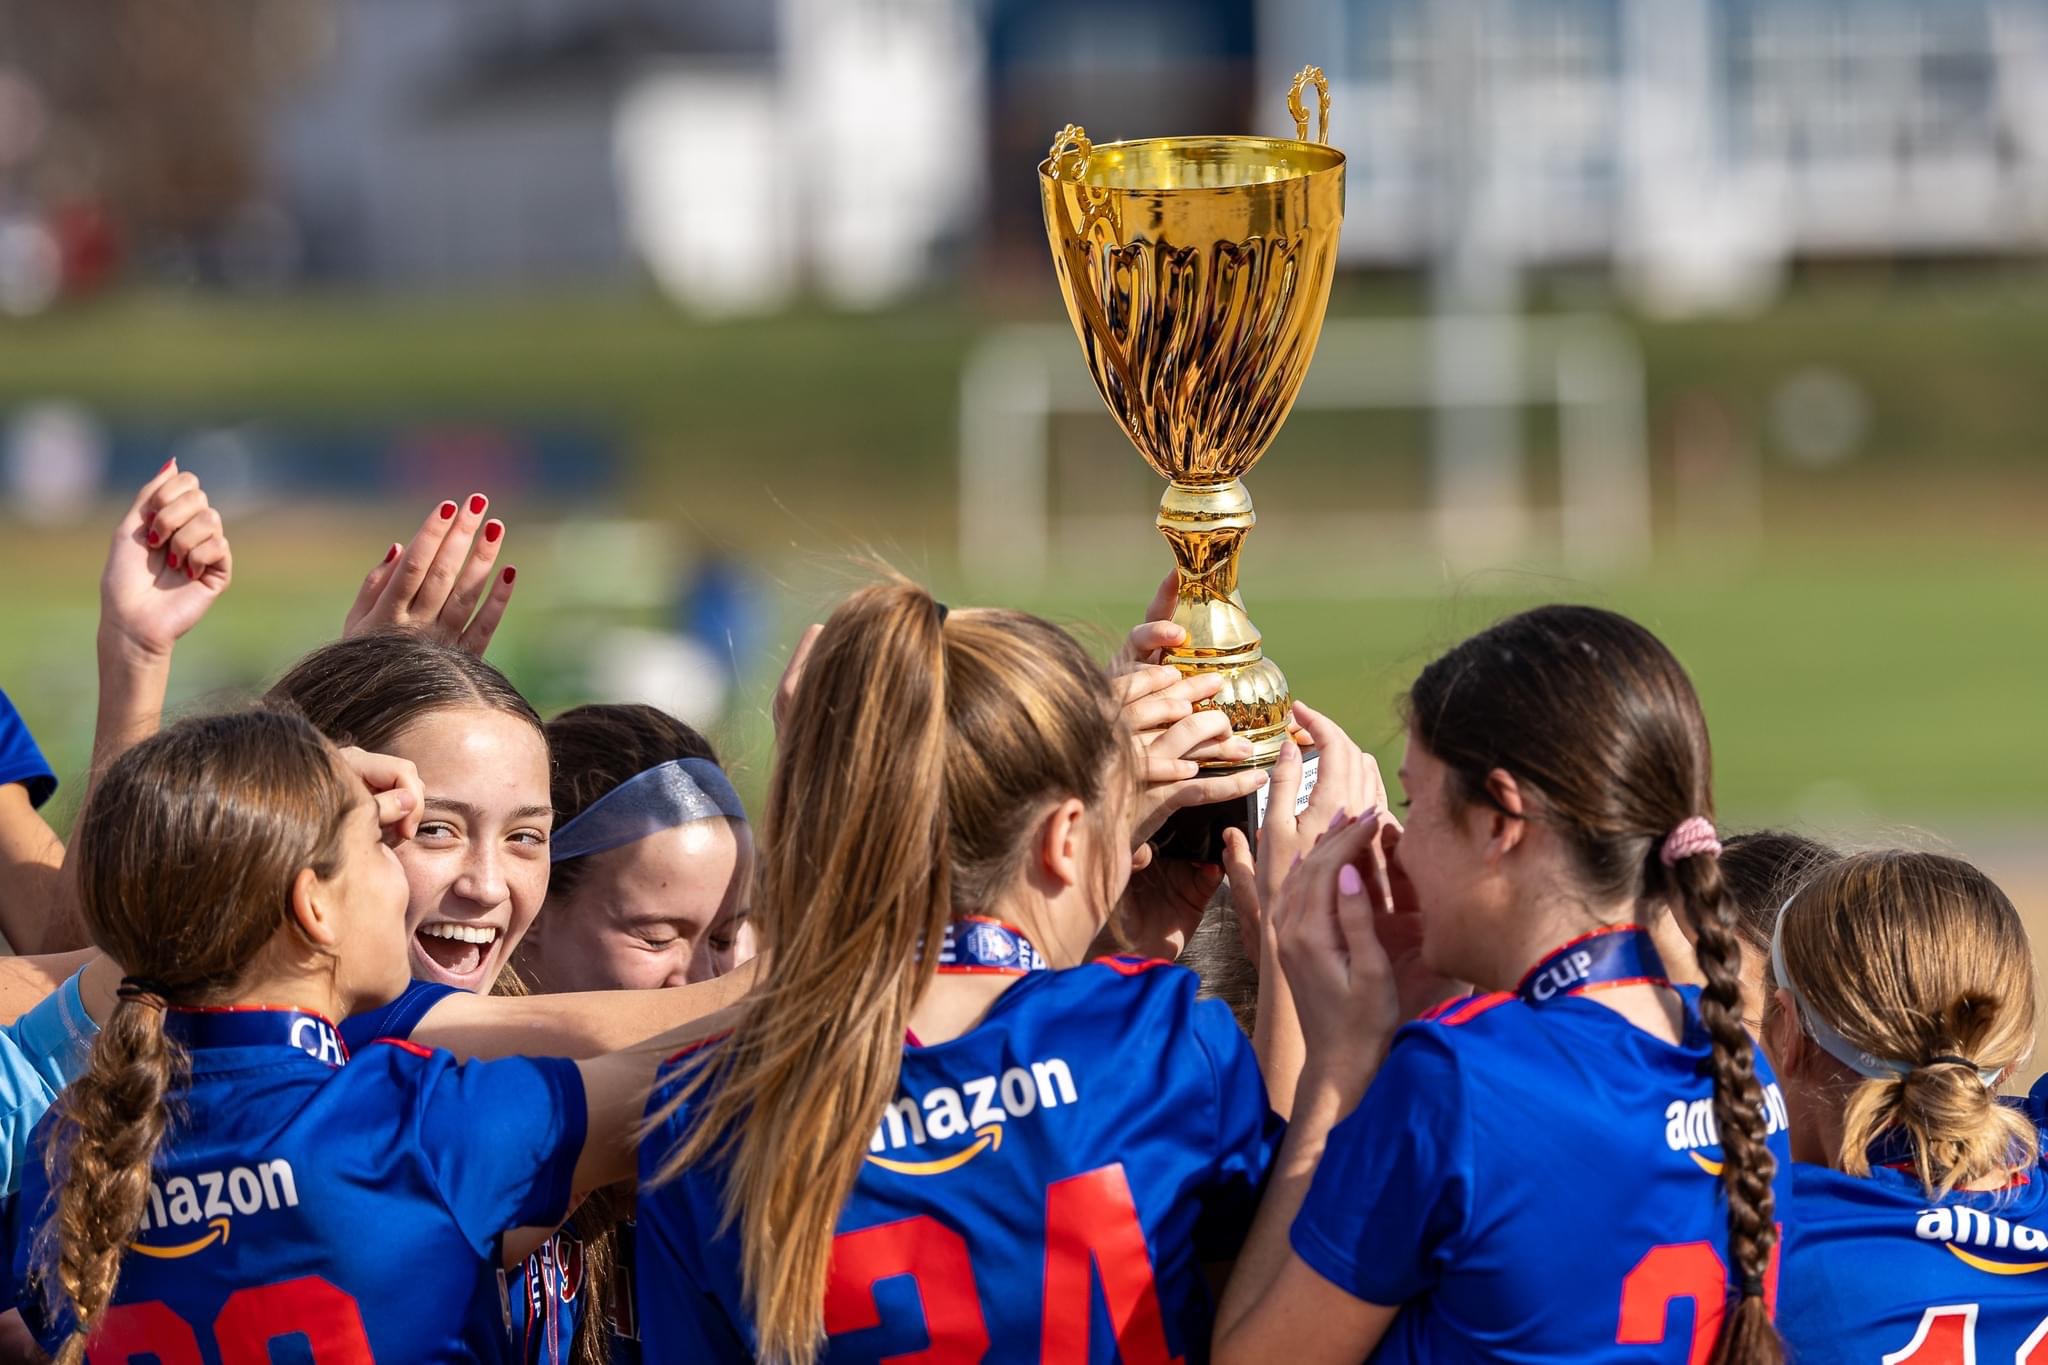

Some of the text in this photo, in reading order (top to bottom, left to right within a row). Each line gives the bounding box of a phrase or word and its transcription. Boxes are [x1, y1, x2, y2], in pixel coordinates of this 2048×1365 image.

[1533, 950, 1592, 1001] CUP
[291, 1016, 346, 1067] CH
[868, 1058, 1079, 1153] mazon
[1665, 1082, 1789, 1151] amon
[139, 1158, 299, 1231] azon
[1915, 1204, 2048, 1252] ama
